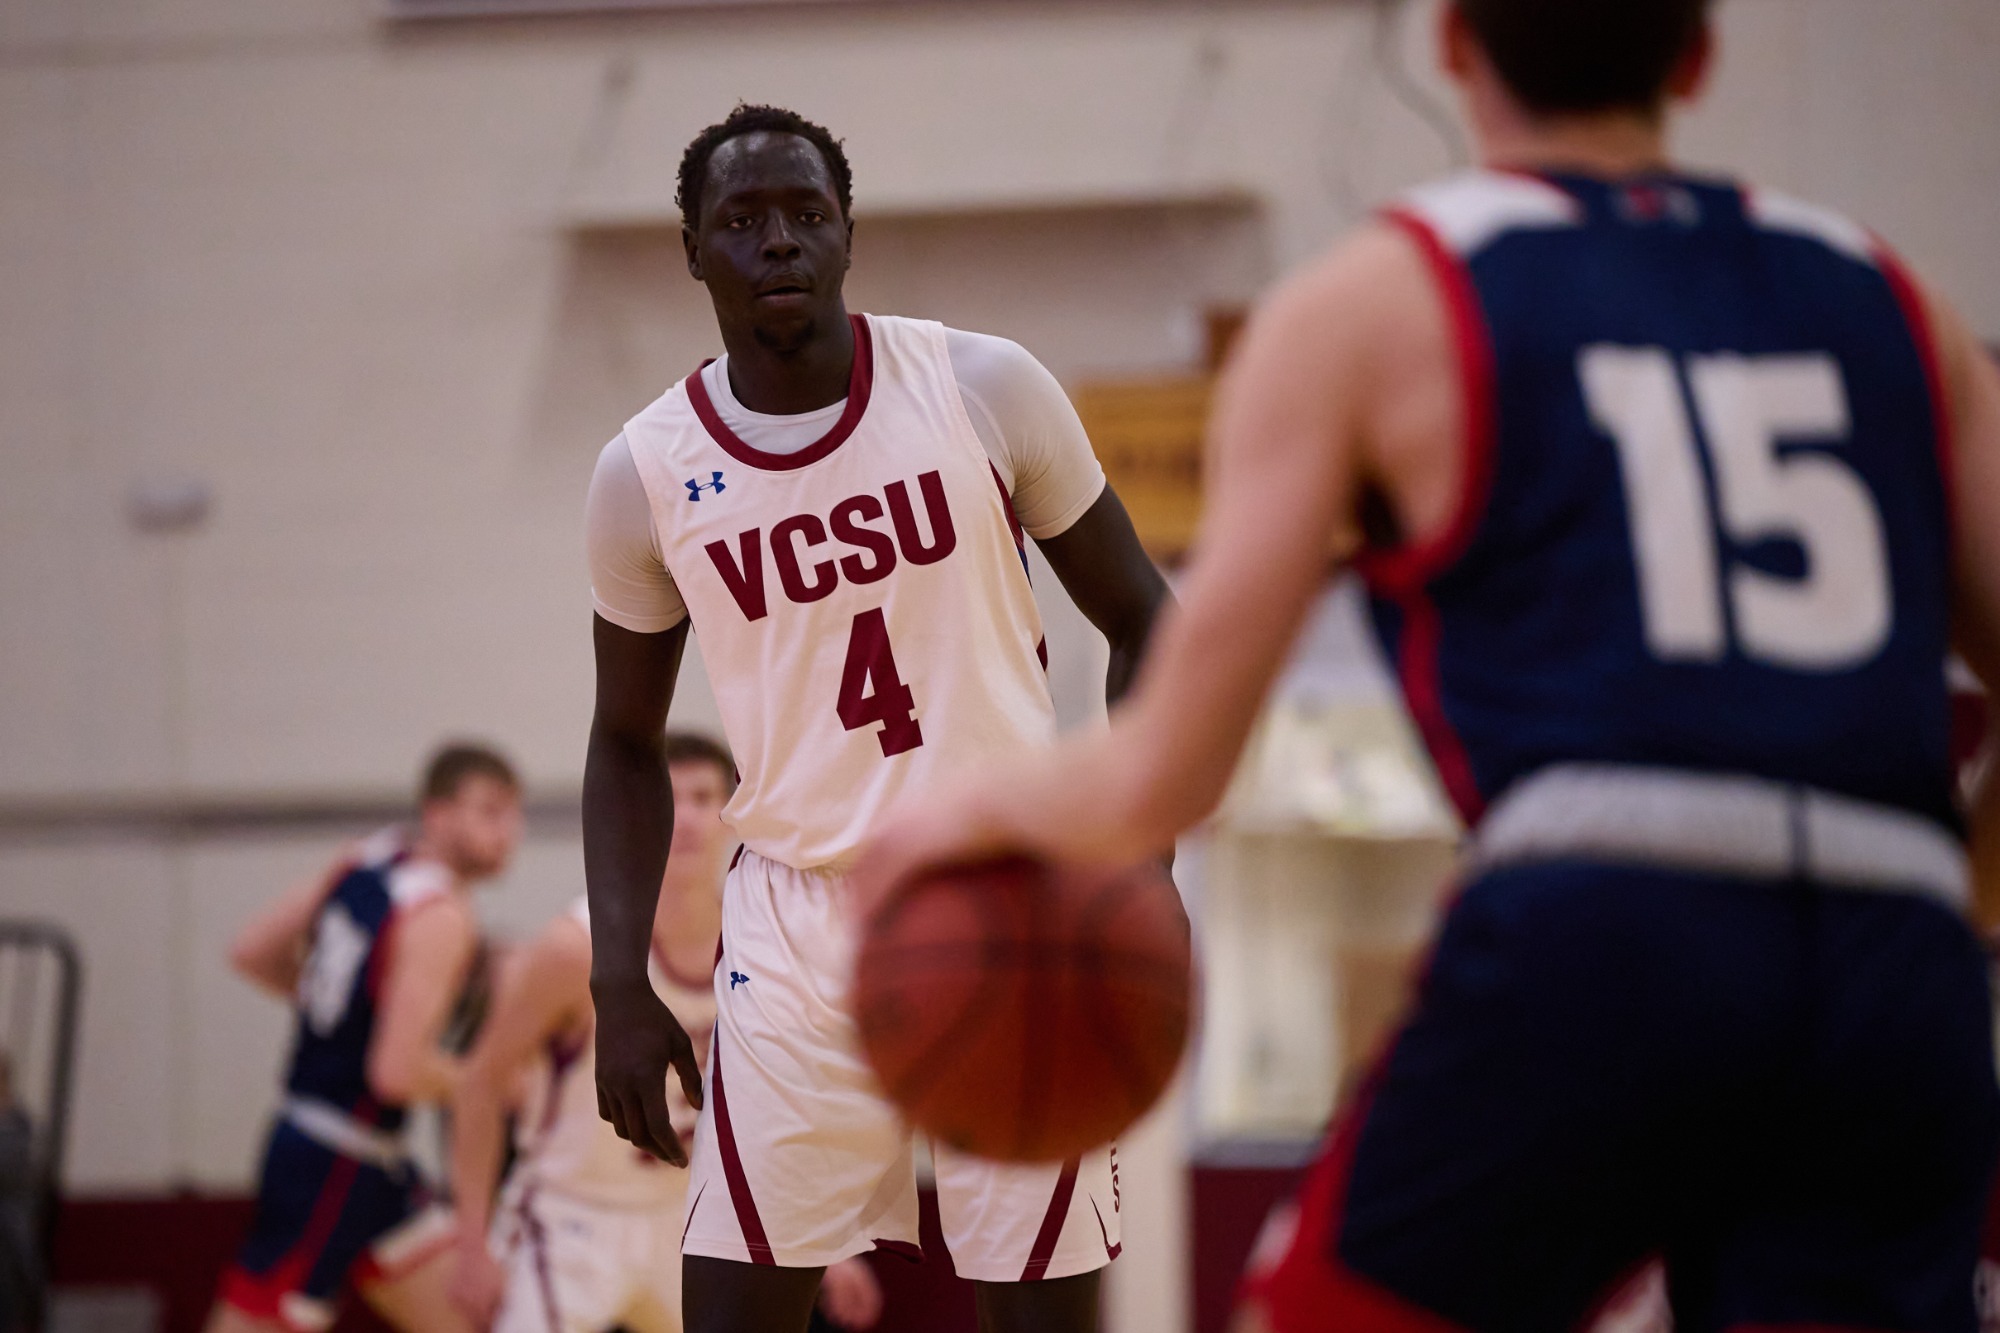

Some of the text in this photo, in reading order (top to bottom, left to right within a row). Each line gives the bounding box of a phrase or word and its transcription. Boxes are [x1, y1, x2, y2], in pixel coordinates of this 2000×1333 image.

[703, 469, 957, 623] VCSU
[1576, 344, 1893, 671] 15
[836, 606, 924, 758] 4
